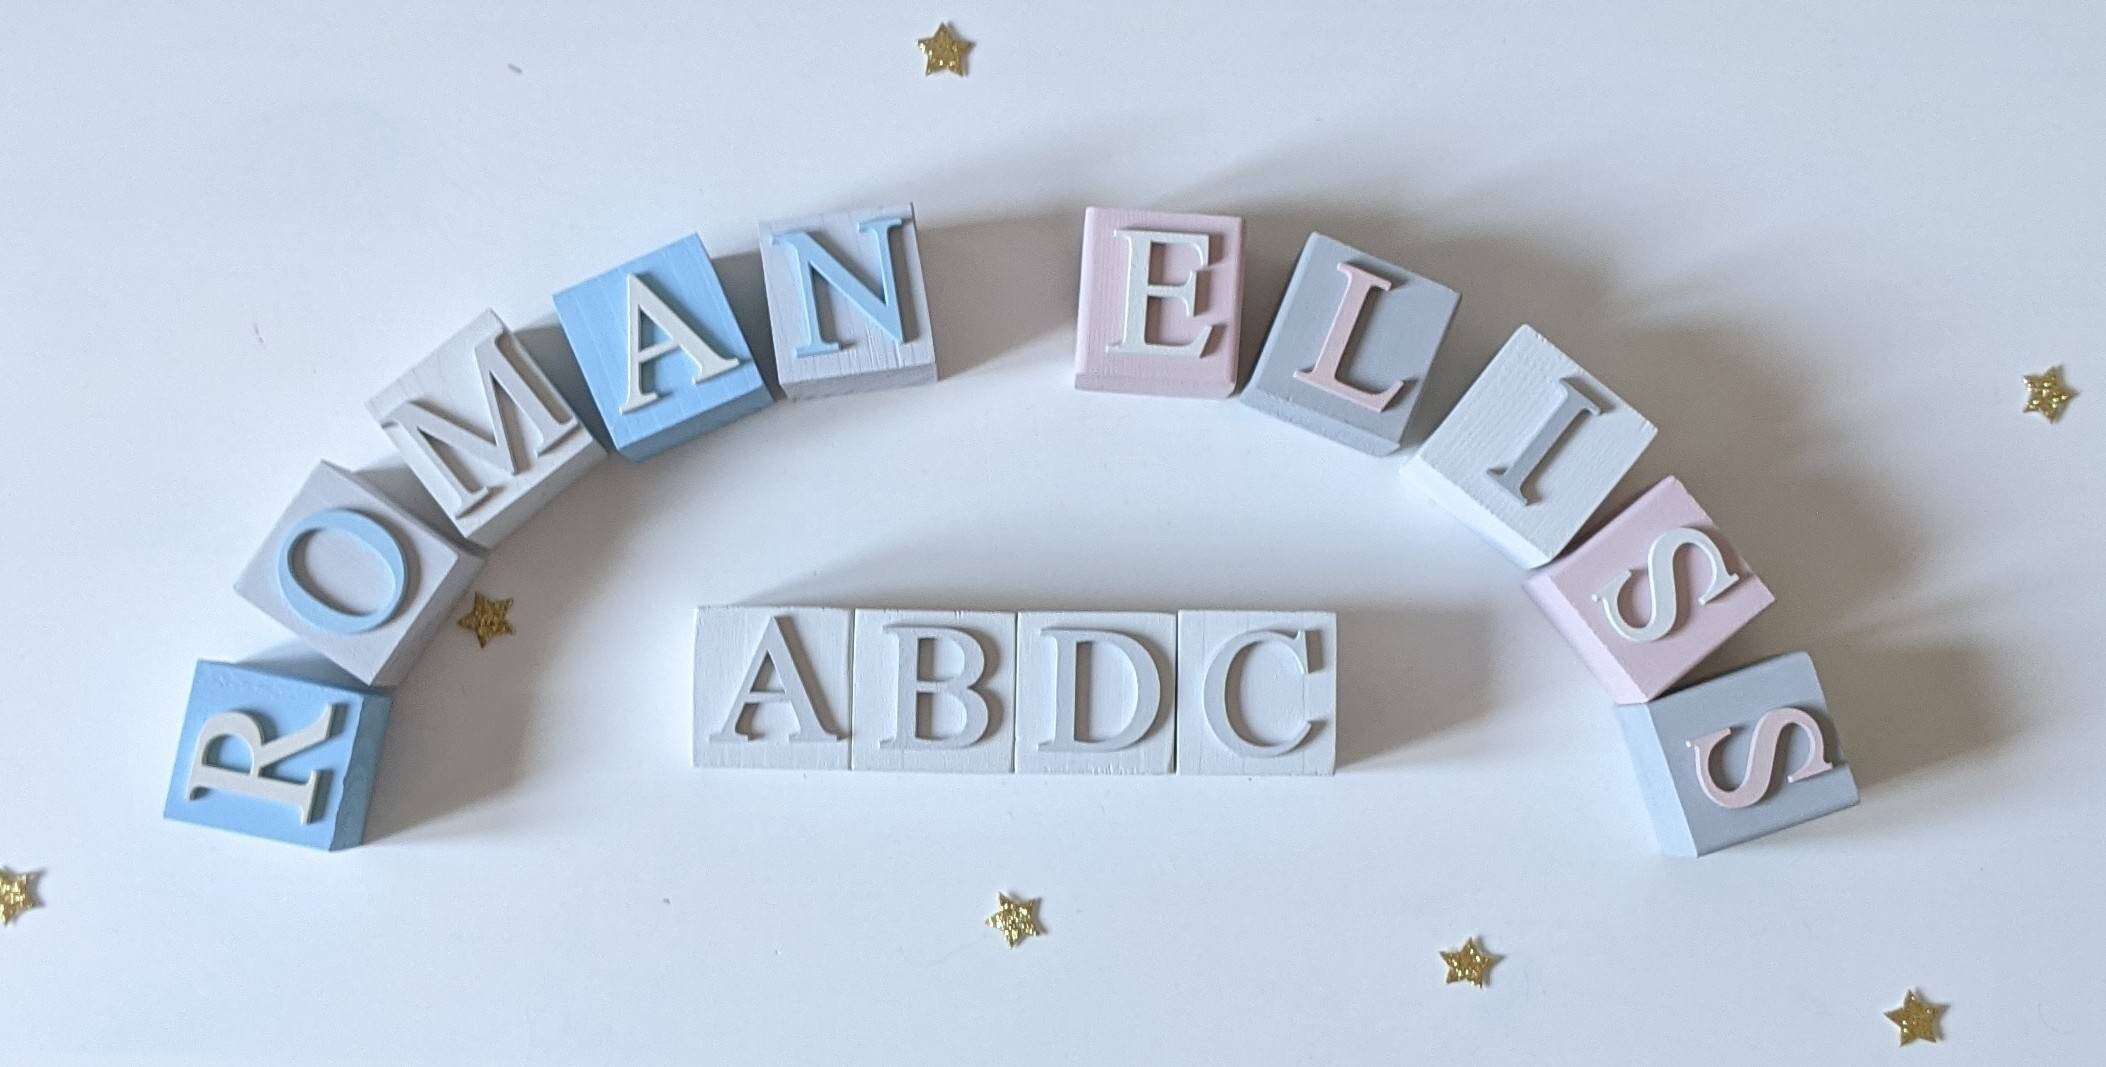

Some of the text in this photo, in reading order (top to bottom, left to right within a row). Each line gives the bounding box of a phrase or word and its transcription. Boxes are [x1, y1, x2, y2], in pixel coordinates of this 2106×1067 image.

[188, 217, 909, 826] ROMAN
[709, 615, 1315, 758] ABDC
[1104, 228, 1837, 809] ELISS
